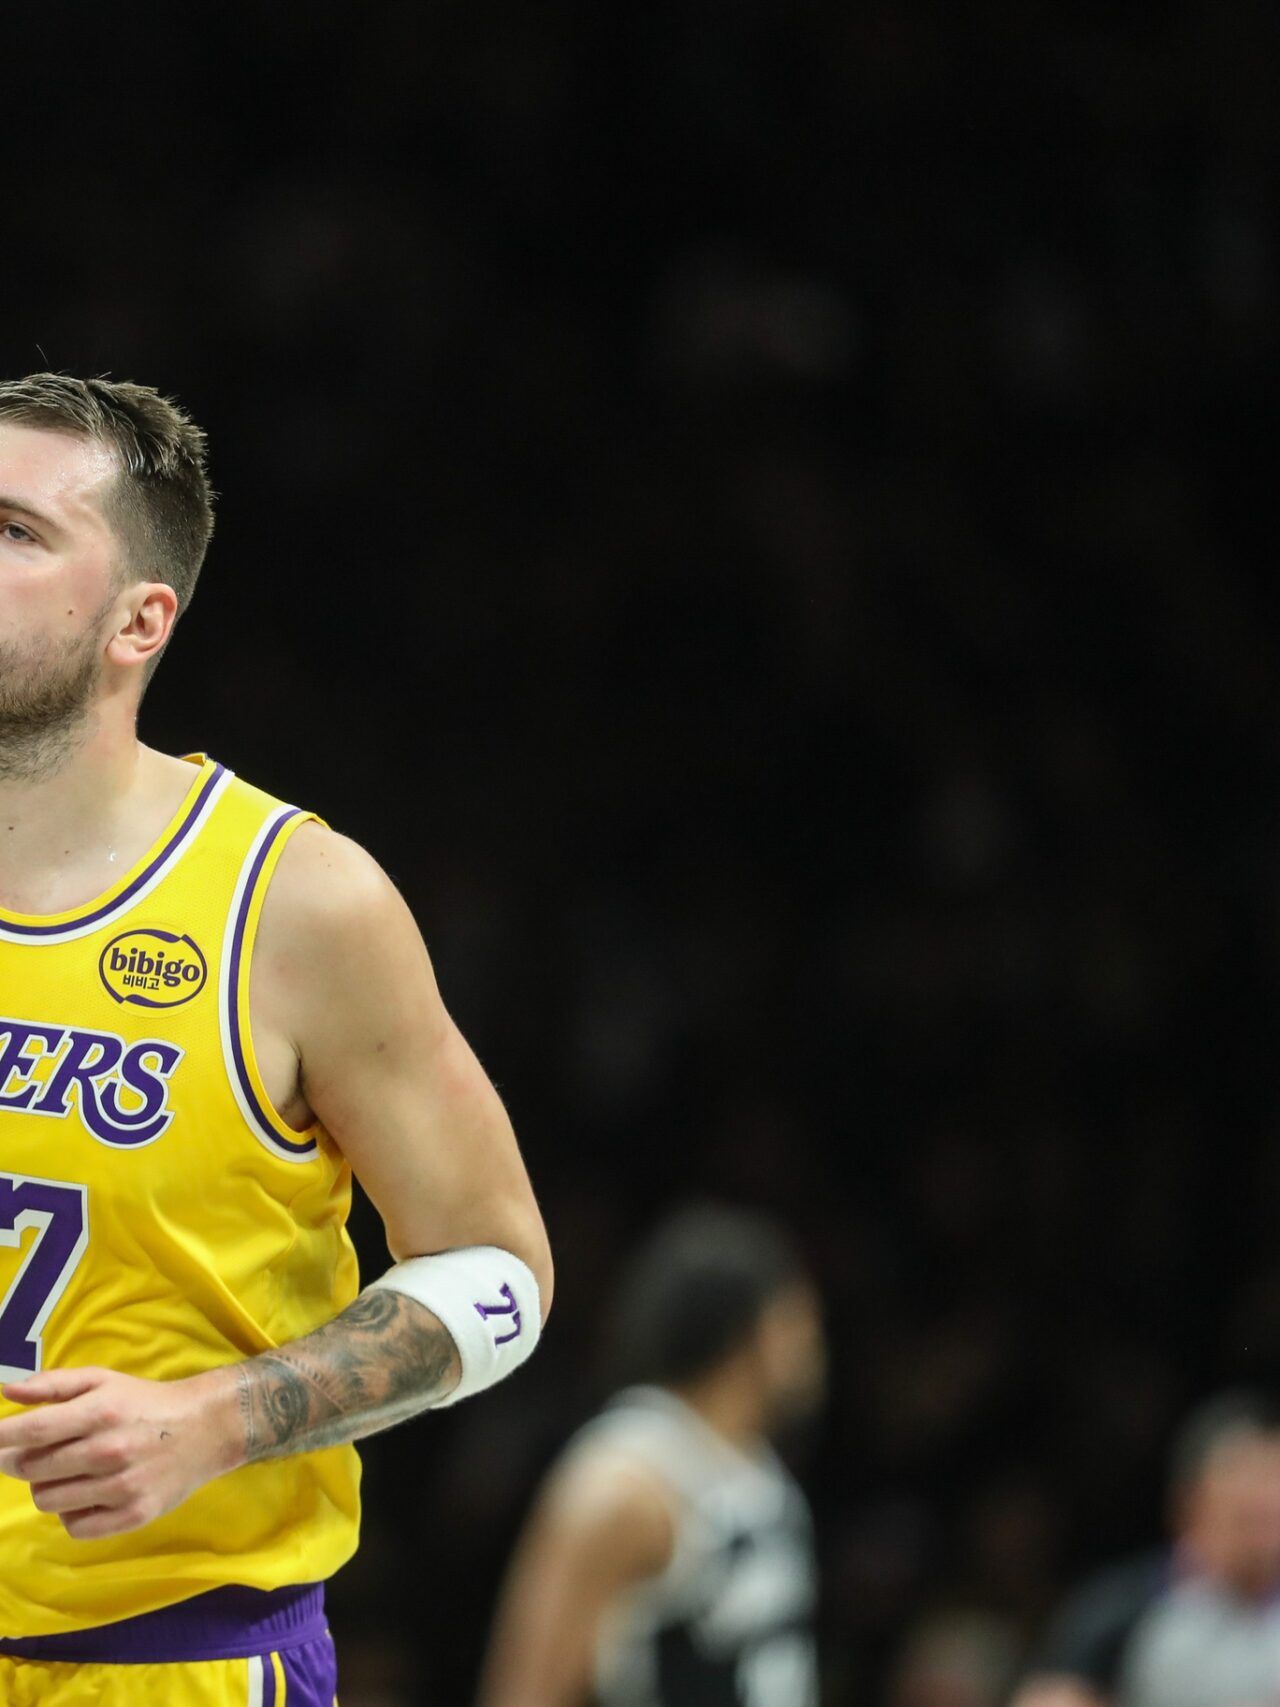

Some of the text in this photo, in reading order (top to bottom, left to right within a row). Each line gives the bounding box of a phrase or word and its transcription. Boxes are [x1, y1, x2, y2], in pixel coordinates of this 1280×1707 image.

[110, 947, 200, 987] bibigo
[122, 974, 160, 991] 비비고
[473, 1282, 522, 1348] 77
